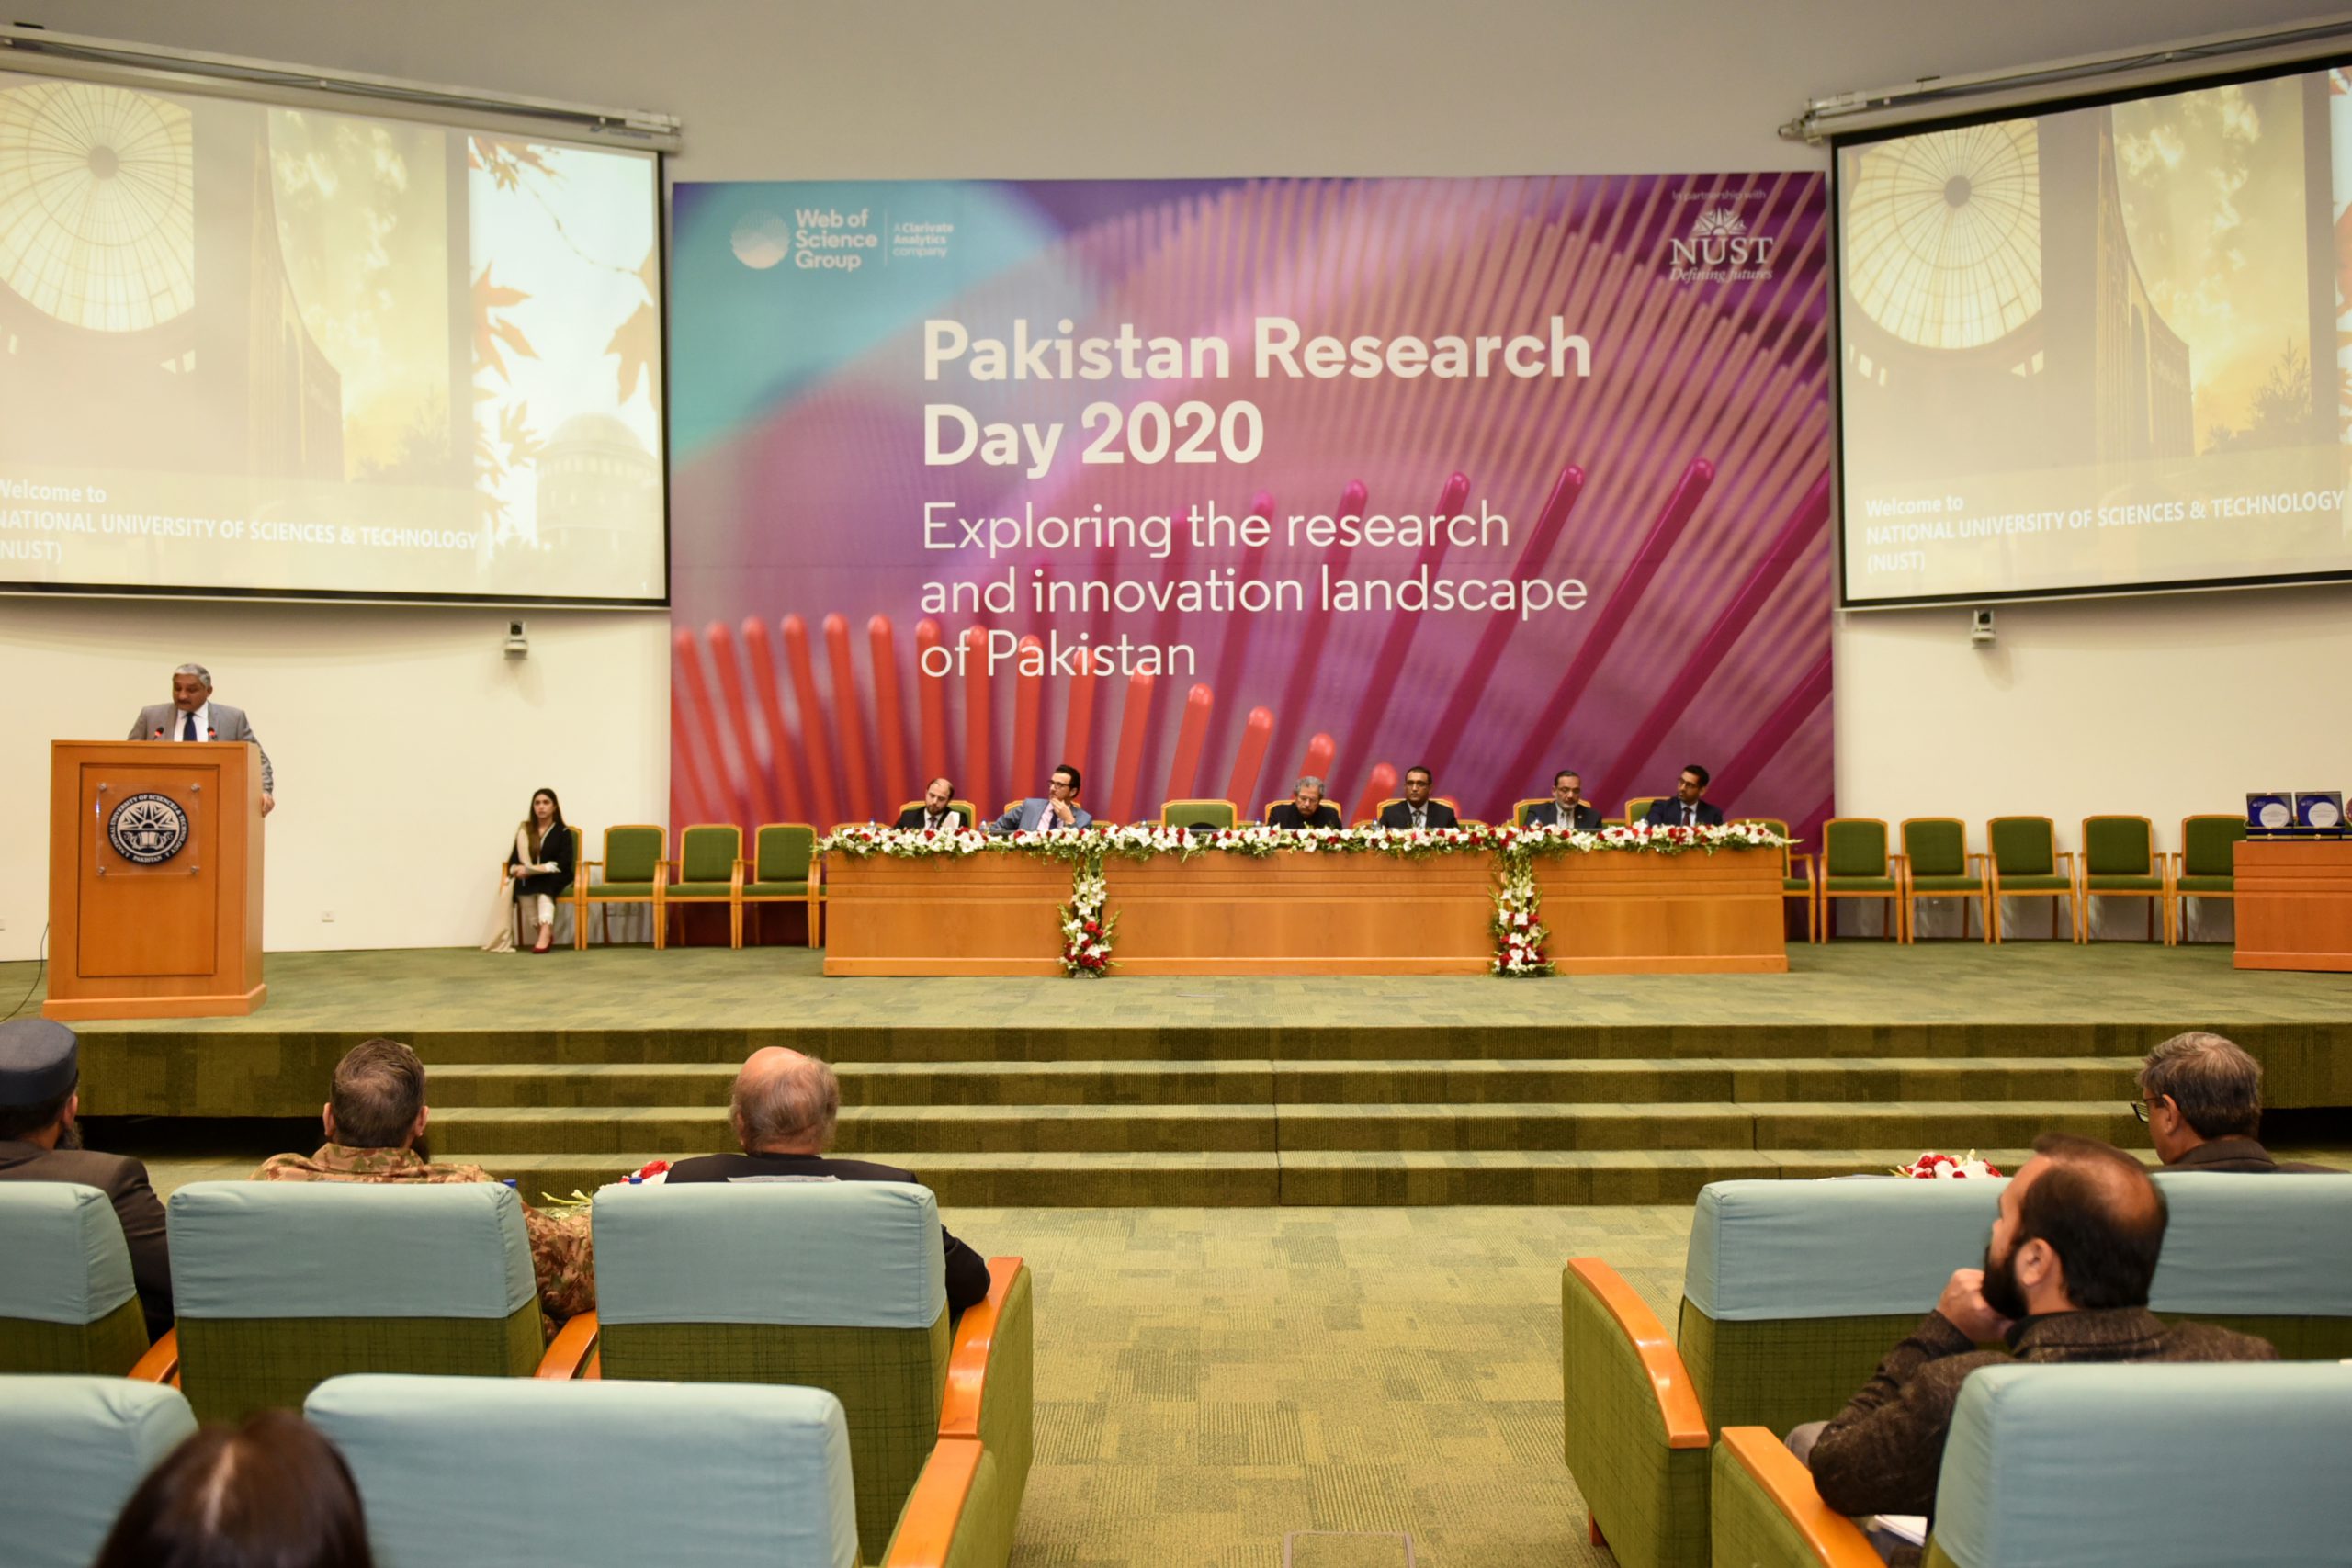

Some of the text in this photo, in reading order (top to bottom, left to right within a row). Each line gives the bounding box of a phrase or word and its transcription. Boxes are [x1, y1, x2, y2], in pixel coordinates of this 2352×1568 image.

[796, 208, 868, 228] Web of
[902, 222, 954, 232] Clarivate
[796, 230, 877, 249] Science
[893, 234, 946, 246] Analytics
[1669, 236, 1773, 265] NUST
[796, 249, 862, 272] Group
[892, 246, 947, 257] company
[1669, 265, 1773, 284] Defining futures
[923, 315, 1591, 381] Pakistan Research
[923, 400, 1264, 479] Day 2020
[87, 485, 107, 503] to
[1865, 495, 1964, 517] Welcome to
[922, 499, 1510, 558] Exploring the research
[1866, 491, 2344, 545] NATIONAL UNIVERSITY OF SCIENCES & TECHNOLOGY
[101, 513, 216, 538] UNIVERSITY
[220, 520, 244, 539] OF
[249, 522, 335, 544] SCIENCES
[340, 526, 356, 544] &
[359, 526, 479, 549] TECHNOLOGY
[0, 540, 62, 564] NUST)
[1867, 551, 1926, 573] (NUST)
[920, 564, 1589, 621] and innovation landscape
[920, 628, 1196, 678] of Pakistan
